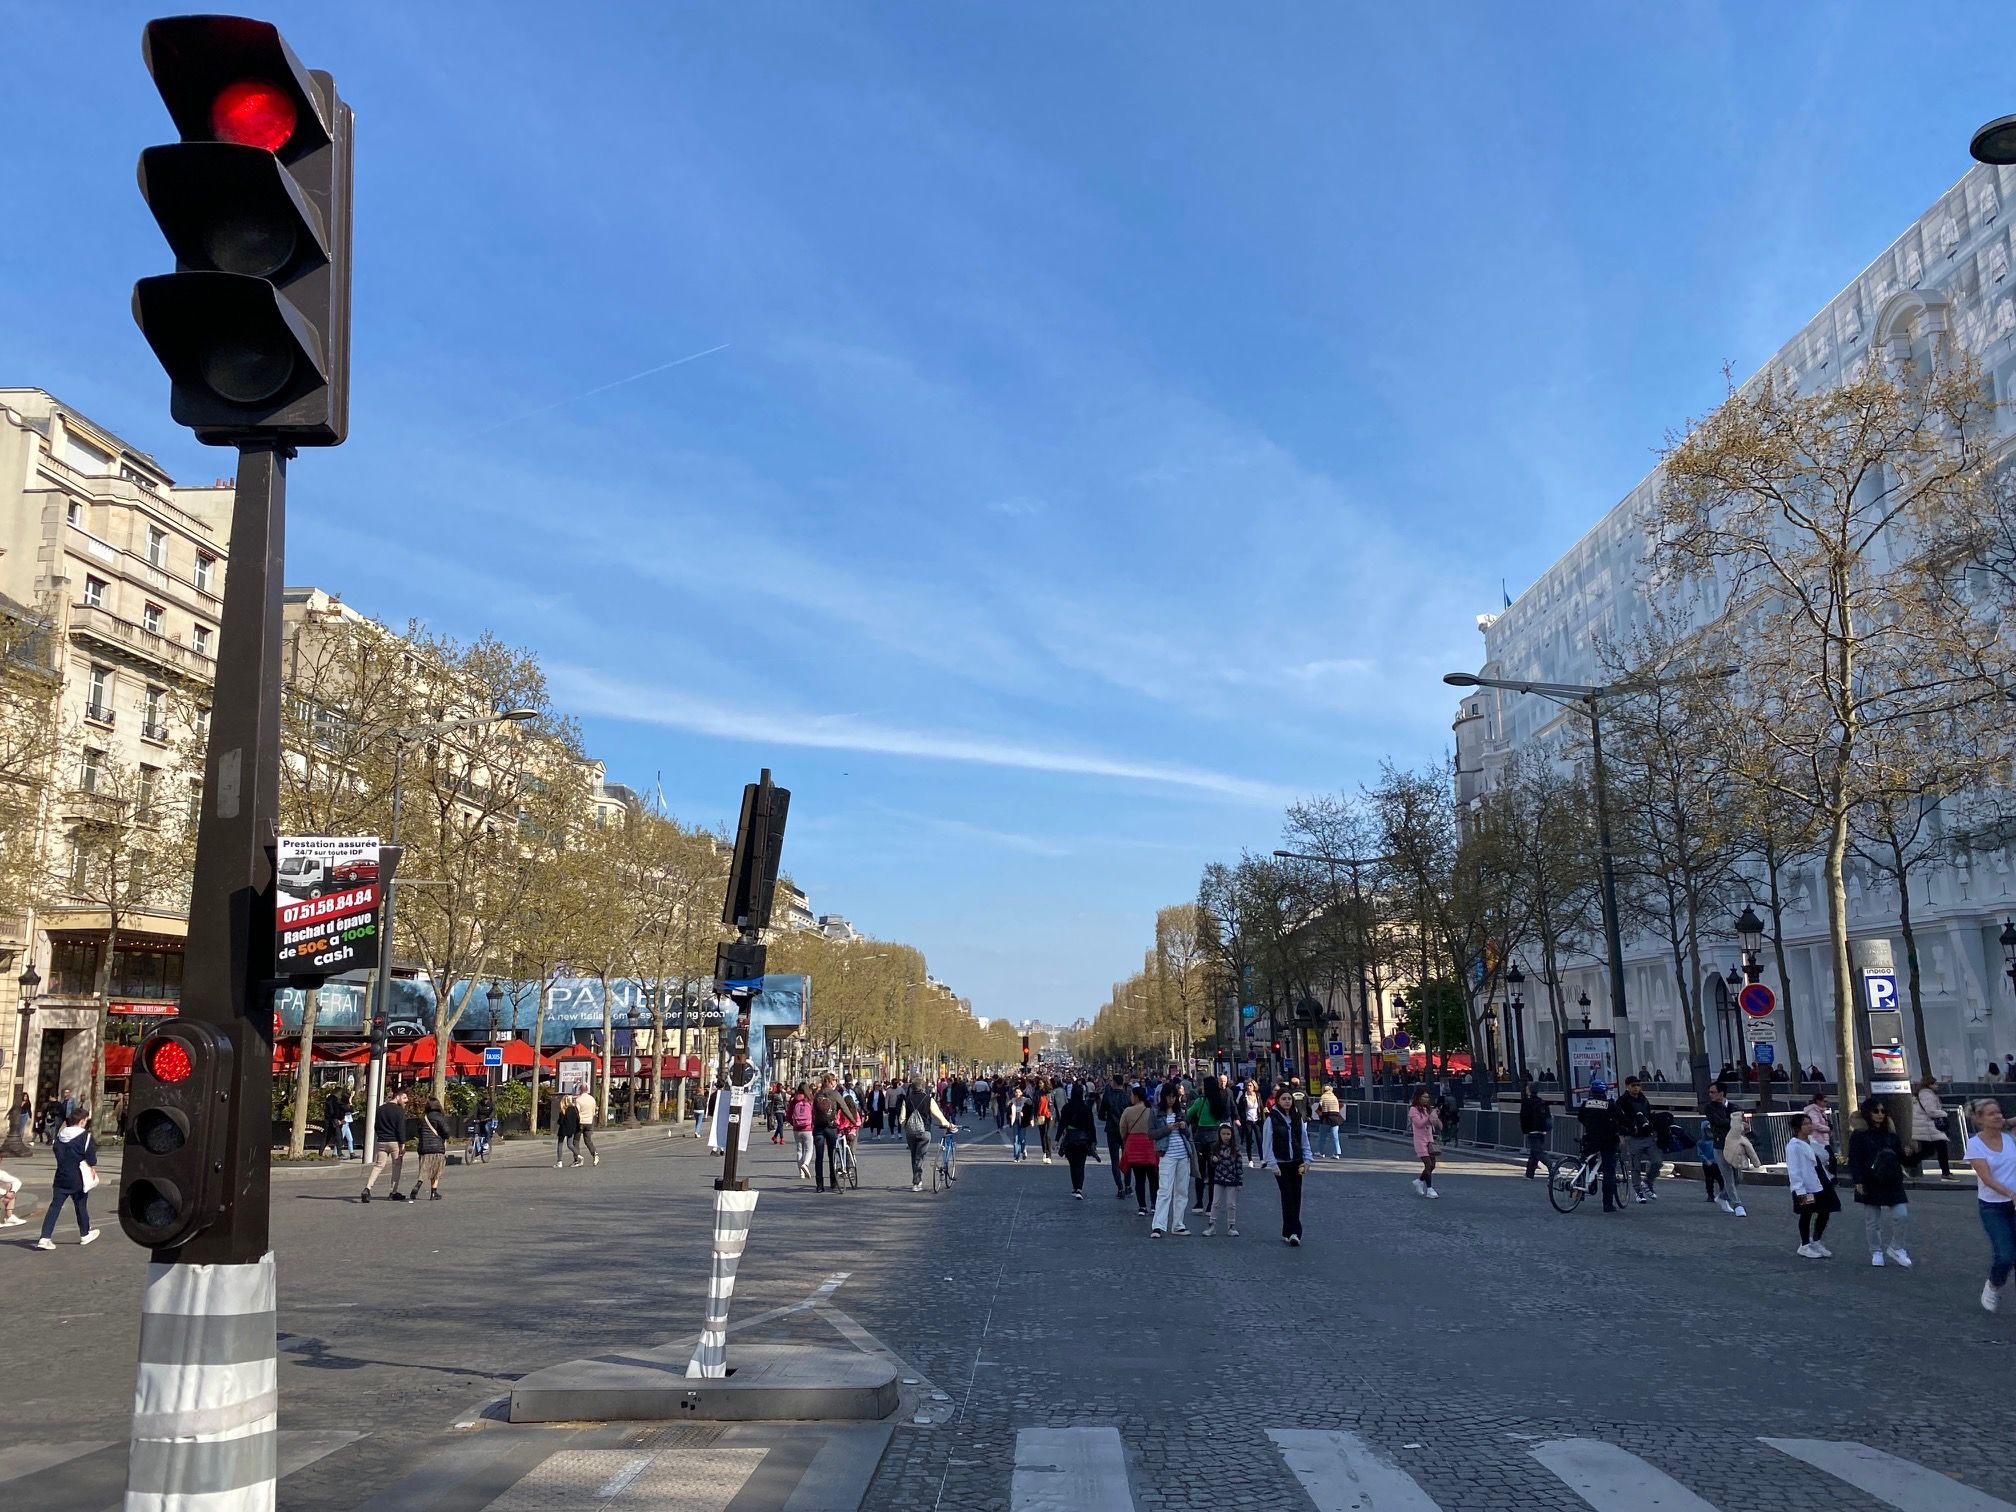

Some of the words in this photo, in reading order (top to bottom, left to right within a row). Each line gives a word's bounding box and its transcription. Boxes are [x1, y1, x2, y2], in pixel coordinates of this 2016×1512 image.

[283, 840, 335, 848] Prestation
[338, 840, 377, 848] assurée
[283, 888, 372, 923] 07.51.58.84.84
[283, 924, 326, 945] Rachat
[326, 920, 334, 934] d
[336, 912, 372, 931] épave
[279, 947, 297, 960] de
[298, 938, 328, 955] 50€
[341, 924, 376, 941] 100€
[313, 945, 354, 966] cash
[281, 989, 358, 1013] PAERAI
[1868, 978, 1894, 1008] P
[580, 1012, 605, 1020] Italia
[1333, 1045, 1340, 1054] P
